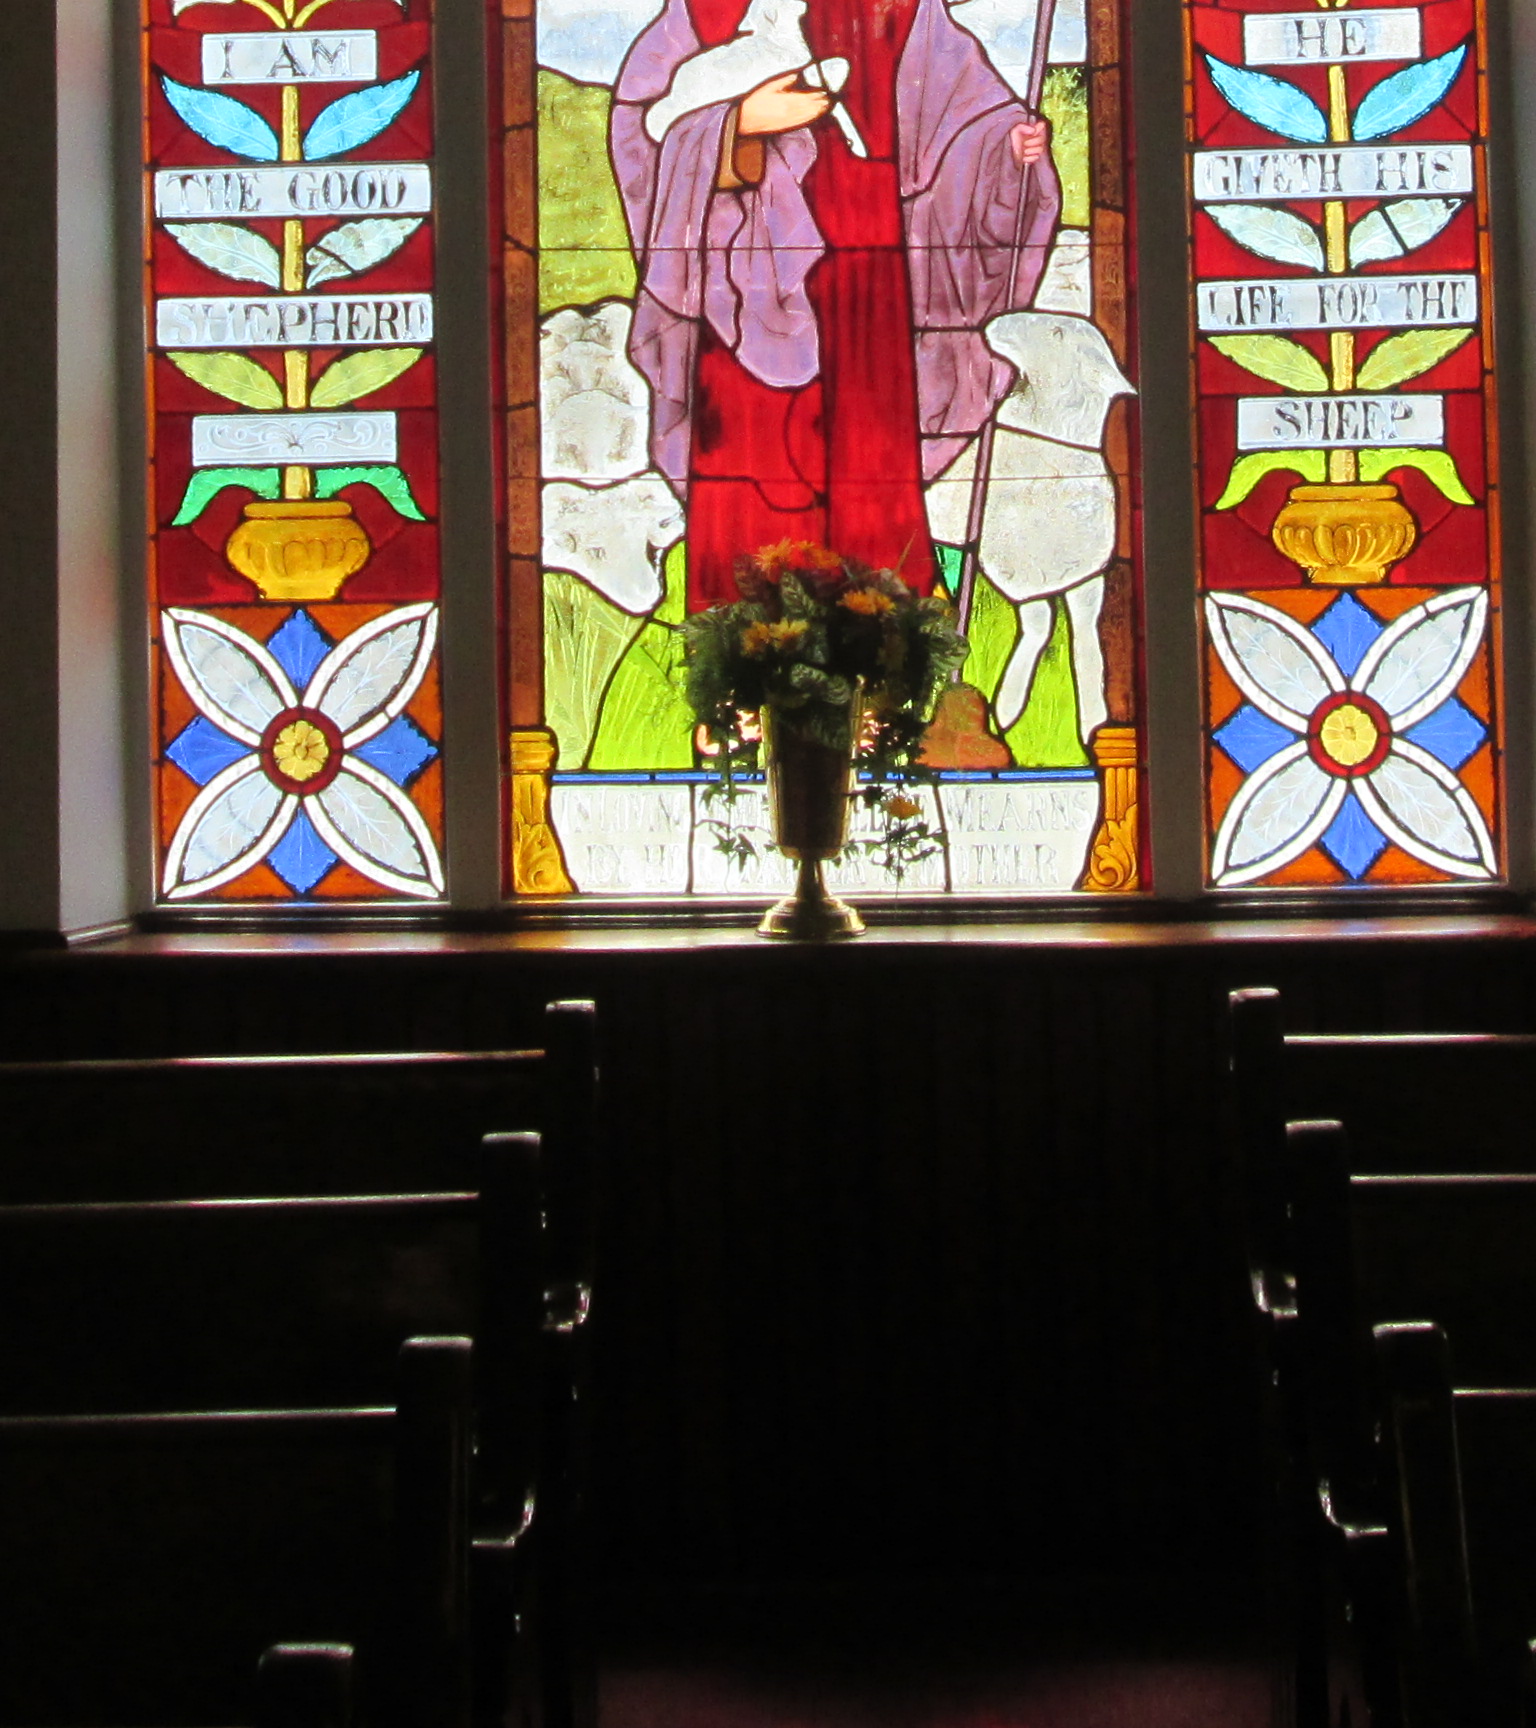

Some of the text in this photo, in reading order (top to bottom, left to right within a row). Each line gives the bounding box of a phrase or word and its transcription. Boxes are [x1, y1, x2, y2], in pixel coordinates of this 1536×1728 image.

[222, 38, 352, 80] I AM
[1293, 18, 1367, 58] HE
[166, 170, 407, 213] THE GOOD
[1204, 150, 1457, 195] GIVETH HIS
[172, 300, 427, 343] SHEPHERD
[1207, 281, 1467, 326] LIFE FOR THE
[1272, 401, 1413, 441] SHEEP
